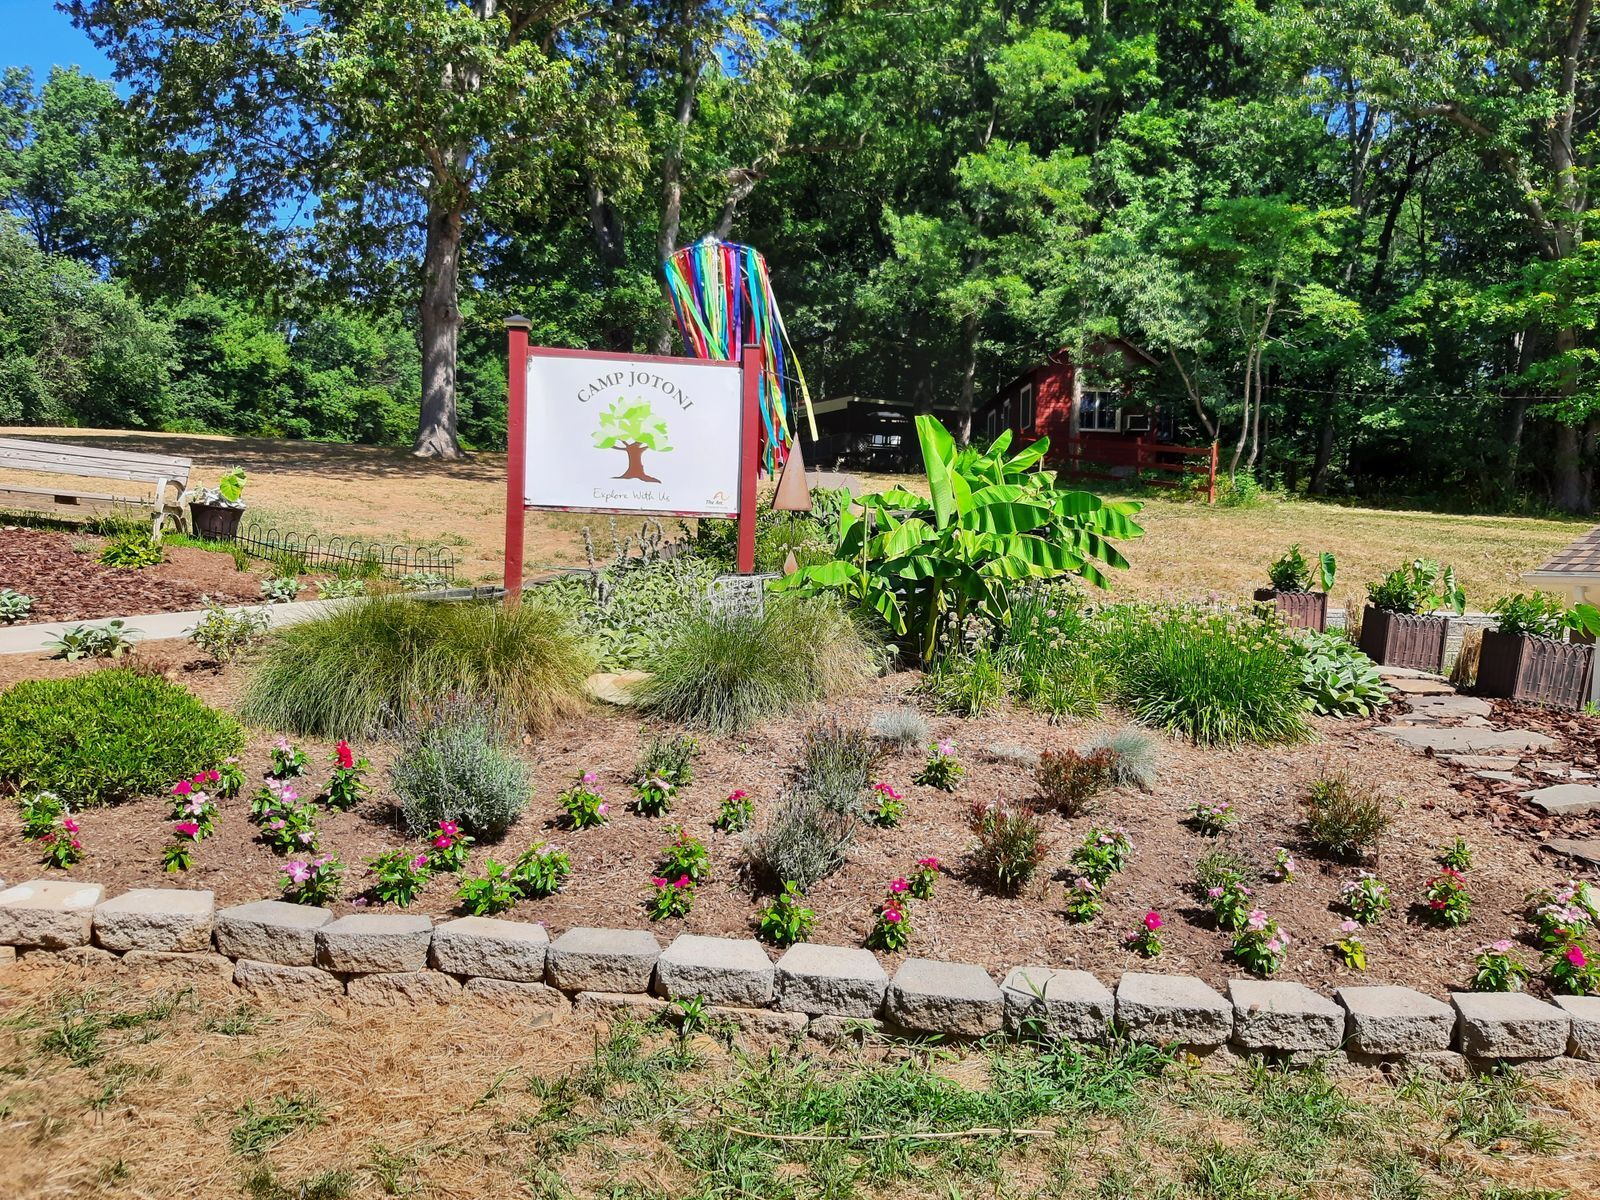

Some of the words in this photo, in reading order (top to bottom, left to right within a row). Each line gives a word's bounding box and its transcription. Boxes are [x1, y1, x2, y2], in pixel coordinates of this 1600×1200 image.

[577, 371, 624, 403] CAMP
[628, 370, 695, 411] JOTONI
[593, 487, 629, 503] Explore
[633, 490, 654, 501] With
[658, 491, 671, 502] Us
